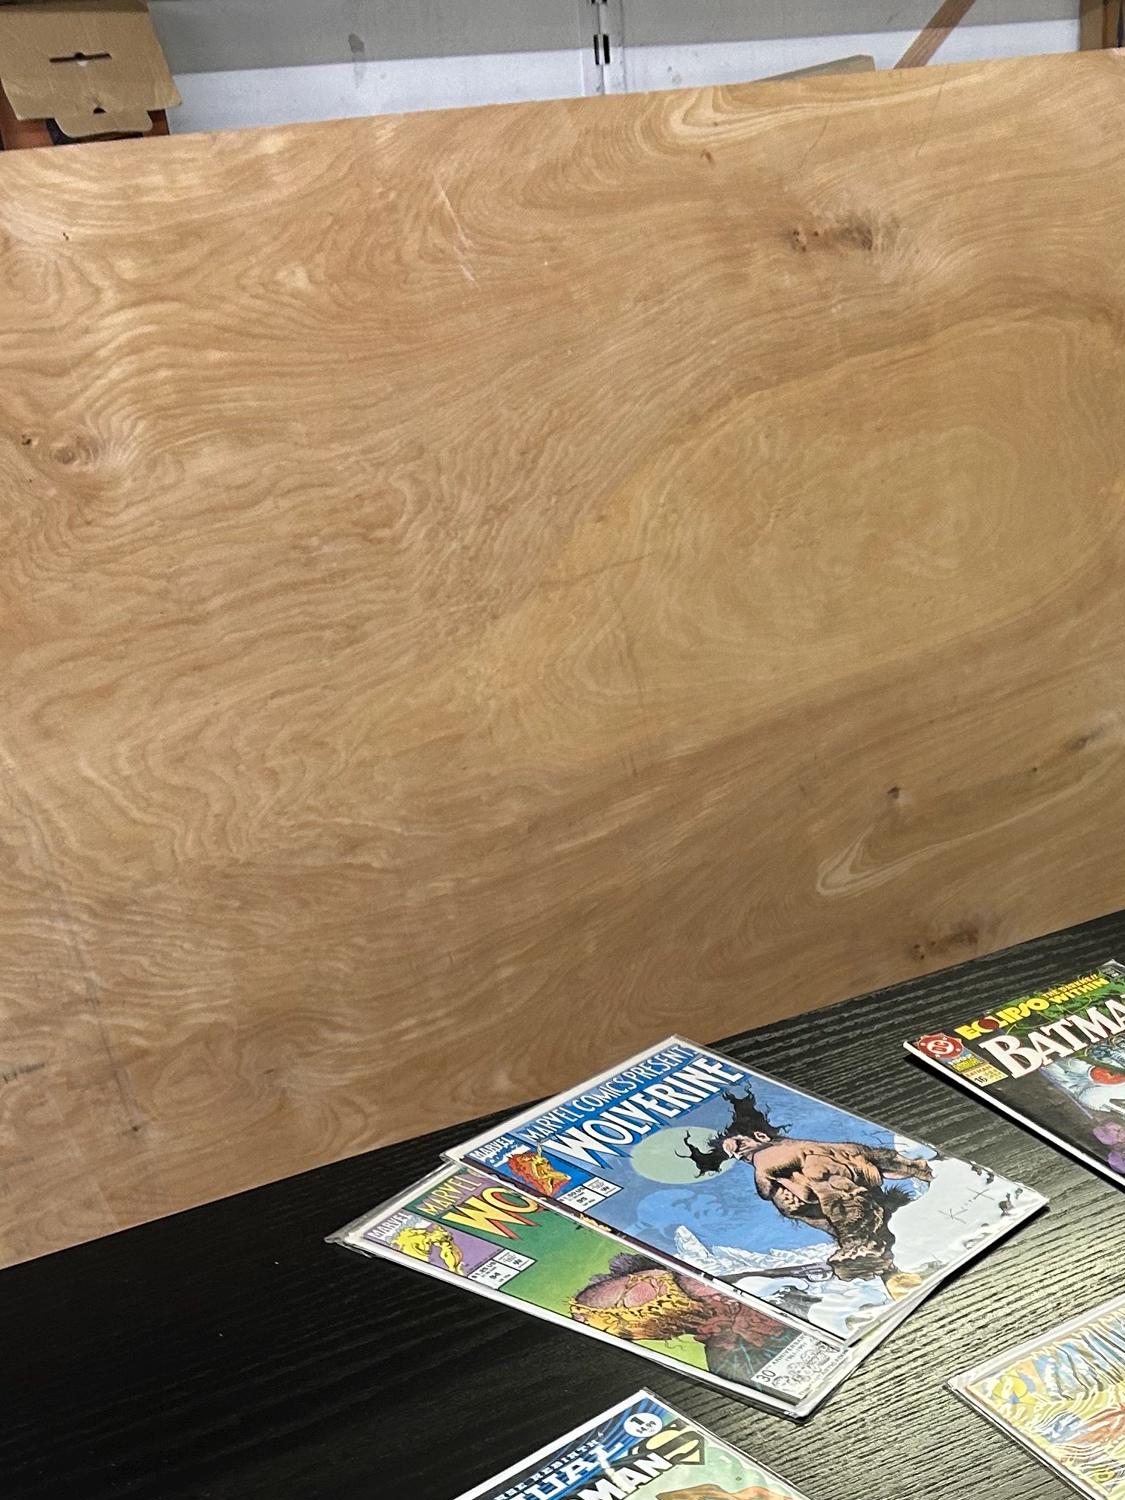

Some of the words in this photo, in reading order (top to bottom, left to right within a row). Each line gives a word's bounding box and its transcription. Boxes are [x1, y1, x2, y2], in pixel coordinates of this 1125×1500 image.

[1050, 977, 1109, 1004] WITHIN
[520, 1105, 579, 1143] MARVEL
[572, 1076, 637, 1113] COMICS
[629, 1046, 698, 1083] PRESENT
[541, 1057, 745, 1168] WOLVERINE
[470, 1136, 515, 1161] MARVEL
[417, 1175, 481, 1216] MARVEL
[367, 1211, 412, 1239] MARVEL
